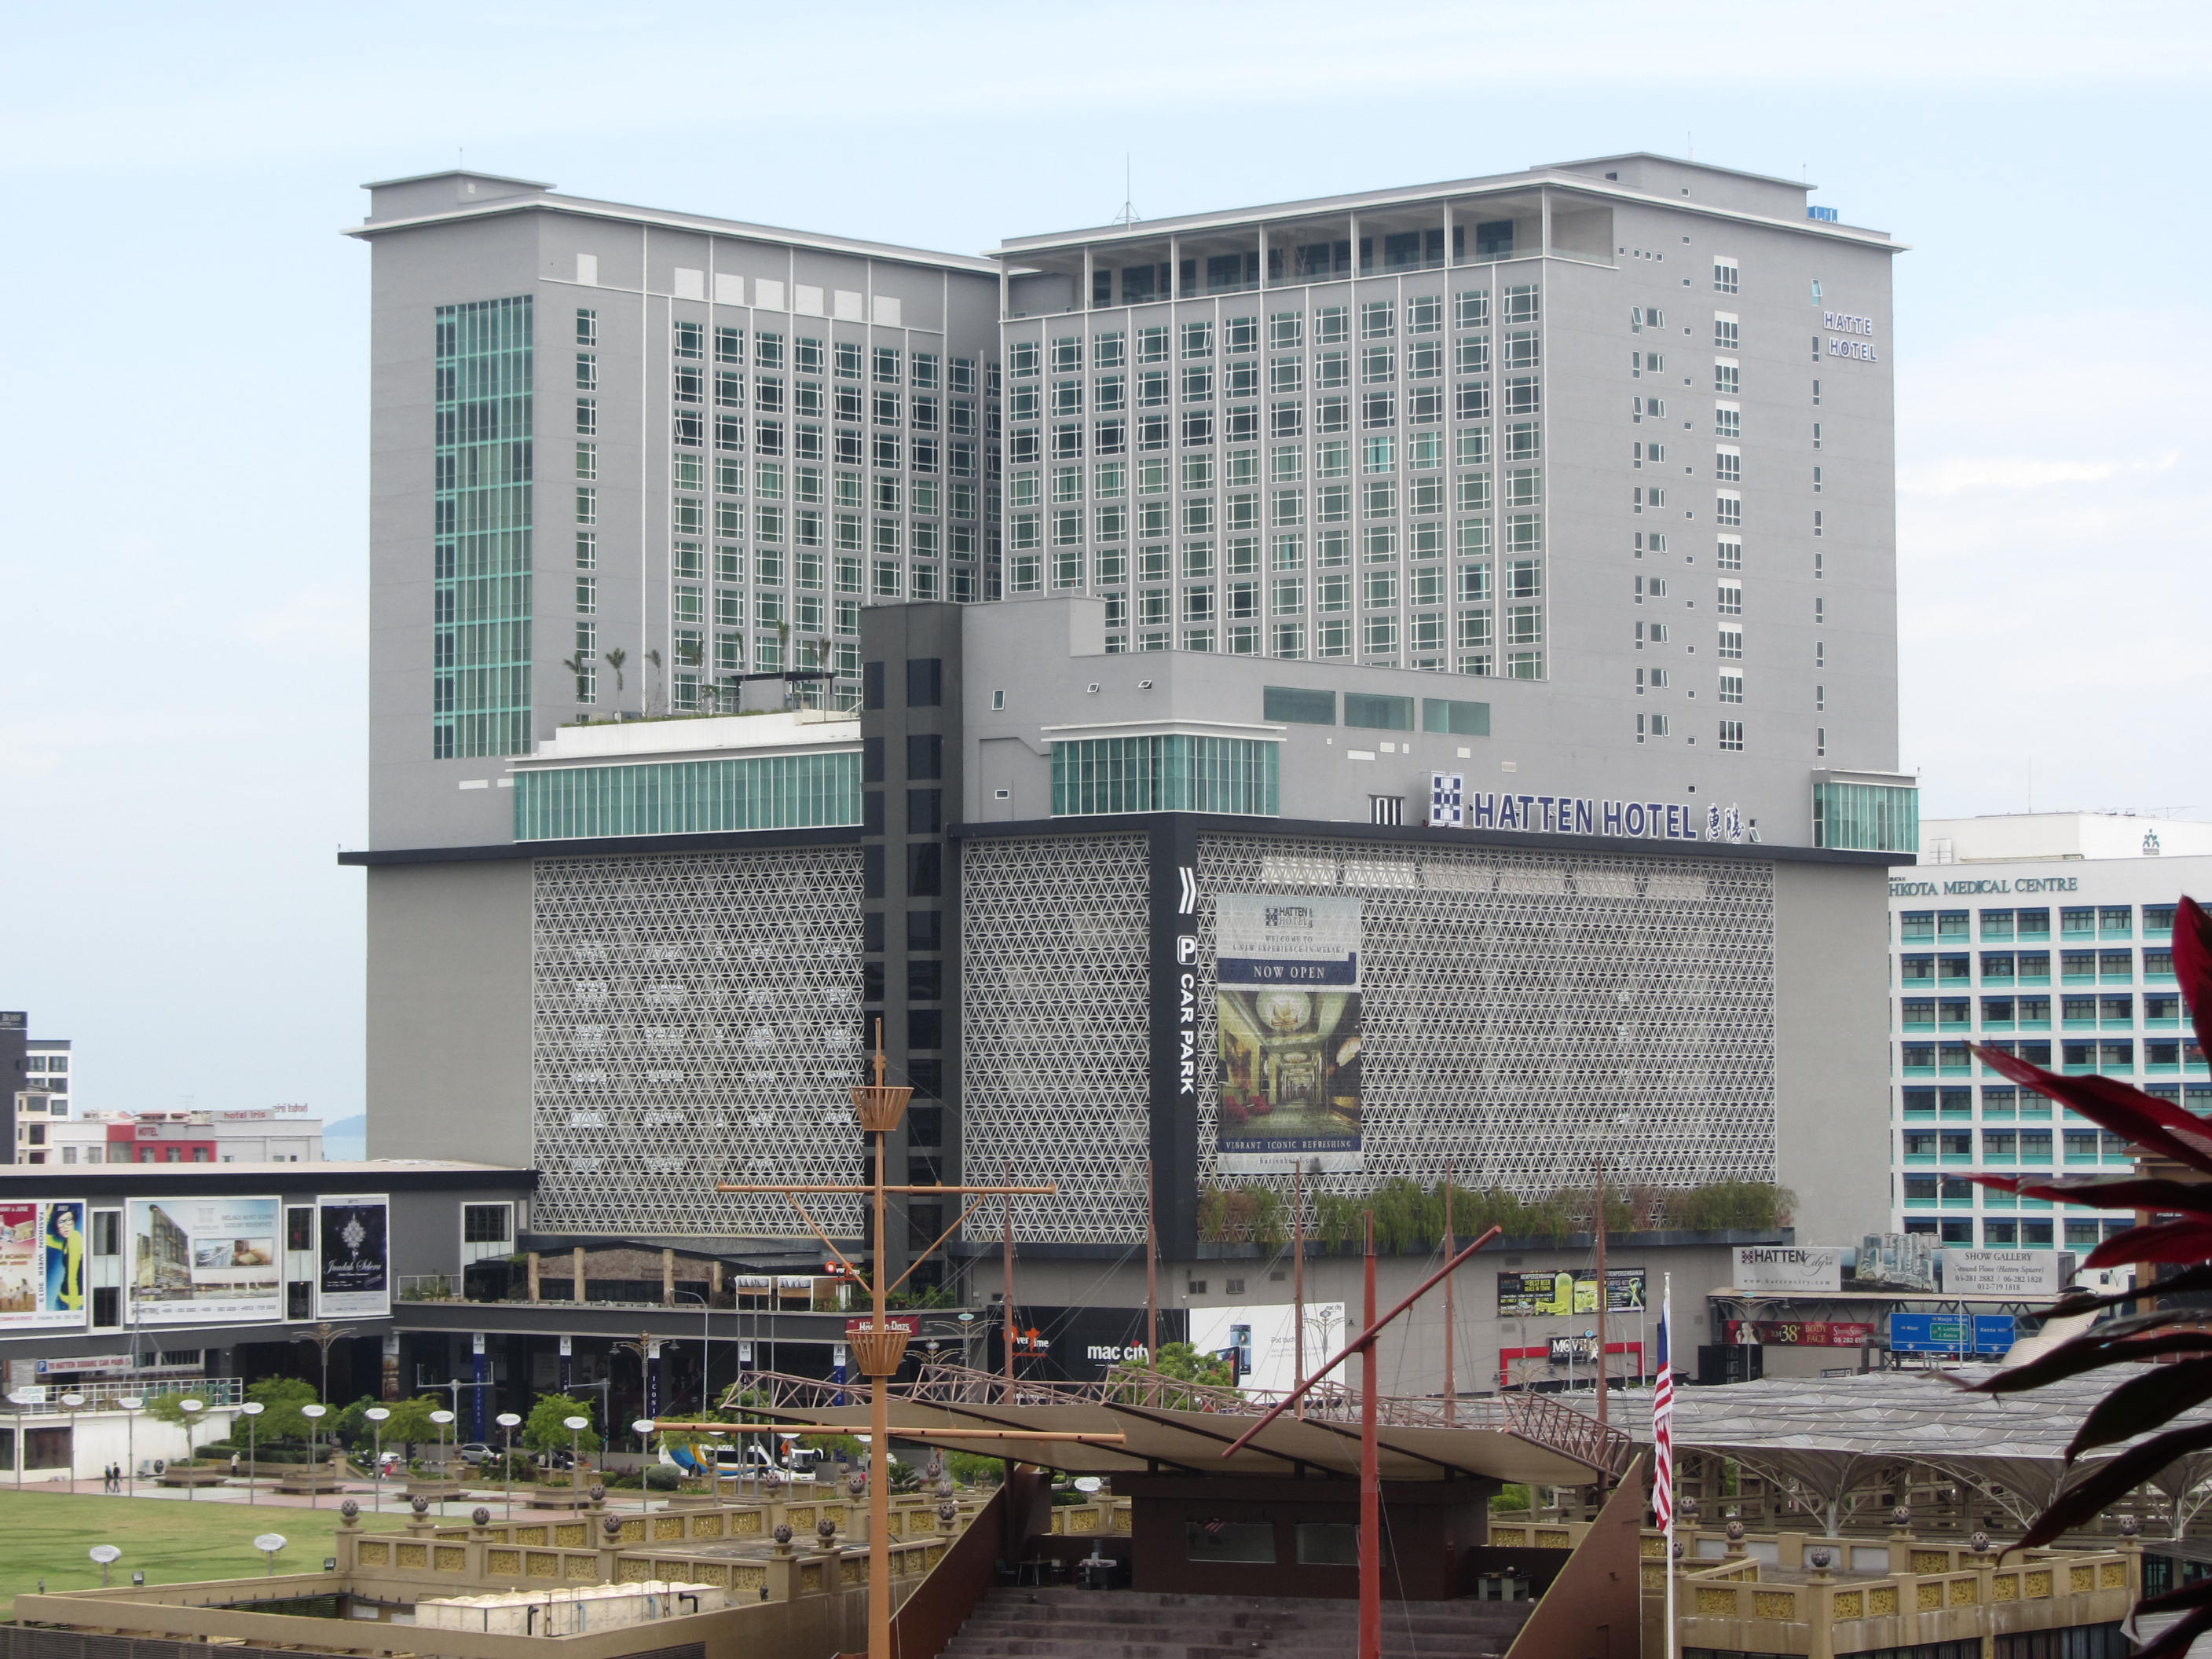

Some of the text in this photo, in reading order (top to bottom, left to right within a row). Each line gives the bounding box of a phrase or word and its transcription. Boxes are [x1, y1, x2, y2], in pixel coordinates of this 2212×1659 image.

[1824, 312, 1873, 336] HATTE
[1829, 338, 1878, 362] HOTEL
[1473, 792, 1697, 840] HATTEN HOTEL
[1944, 881, 2011, 895] MEDICAL
[2015, 877, 2078, 893] CENTRE
[1279, 906, 1307, 917] HATTEN
[1279, 917, 1307, 926] HOTEL
[1181, 939, 1196, 962] P
[1254, 966, 1325, 979] NOW OPEN
[1181, 973, 1194, 1095] CAR PARK
[137, 1126, 159, 1137] HOTEL
[1267, 1141, 1297, 1149] ICONIC
[1302, 1140, 1351, 1148] REFRESHING
[1754, 1250, 1805, 1263] HATTEN
[1965, 1252, 2033, 1261] SHOW GALLERY
[859, 1320, 910, 1331] Hän-Dazs
[1805, 1324, 1828, 1333] BODY
[1087, 1339, 1150, 1364] mac city
